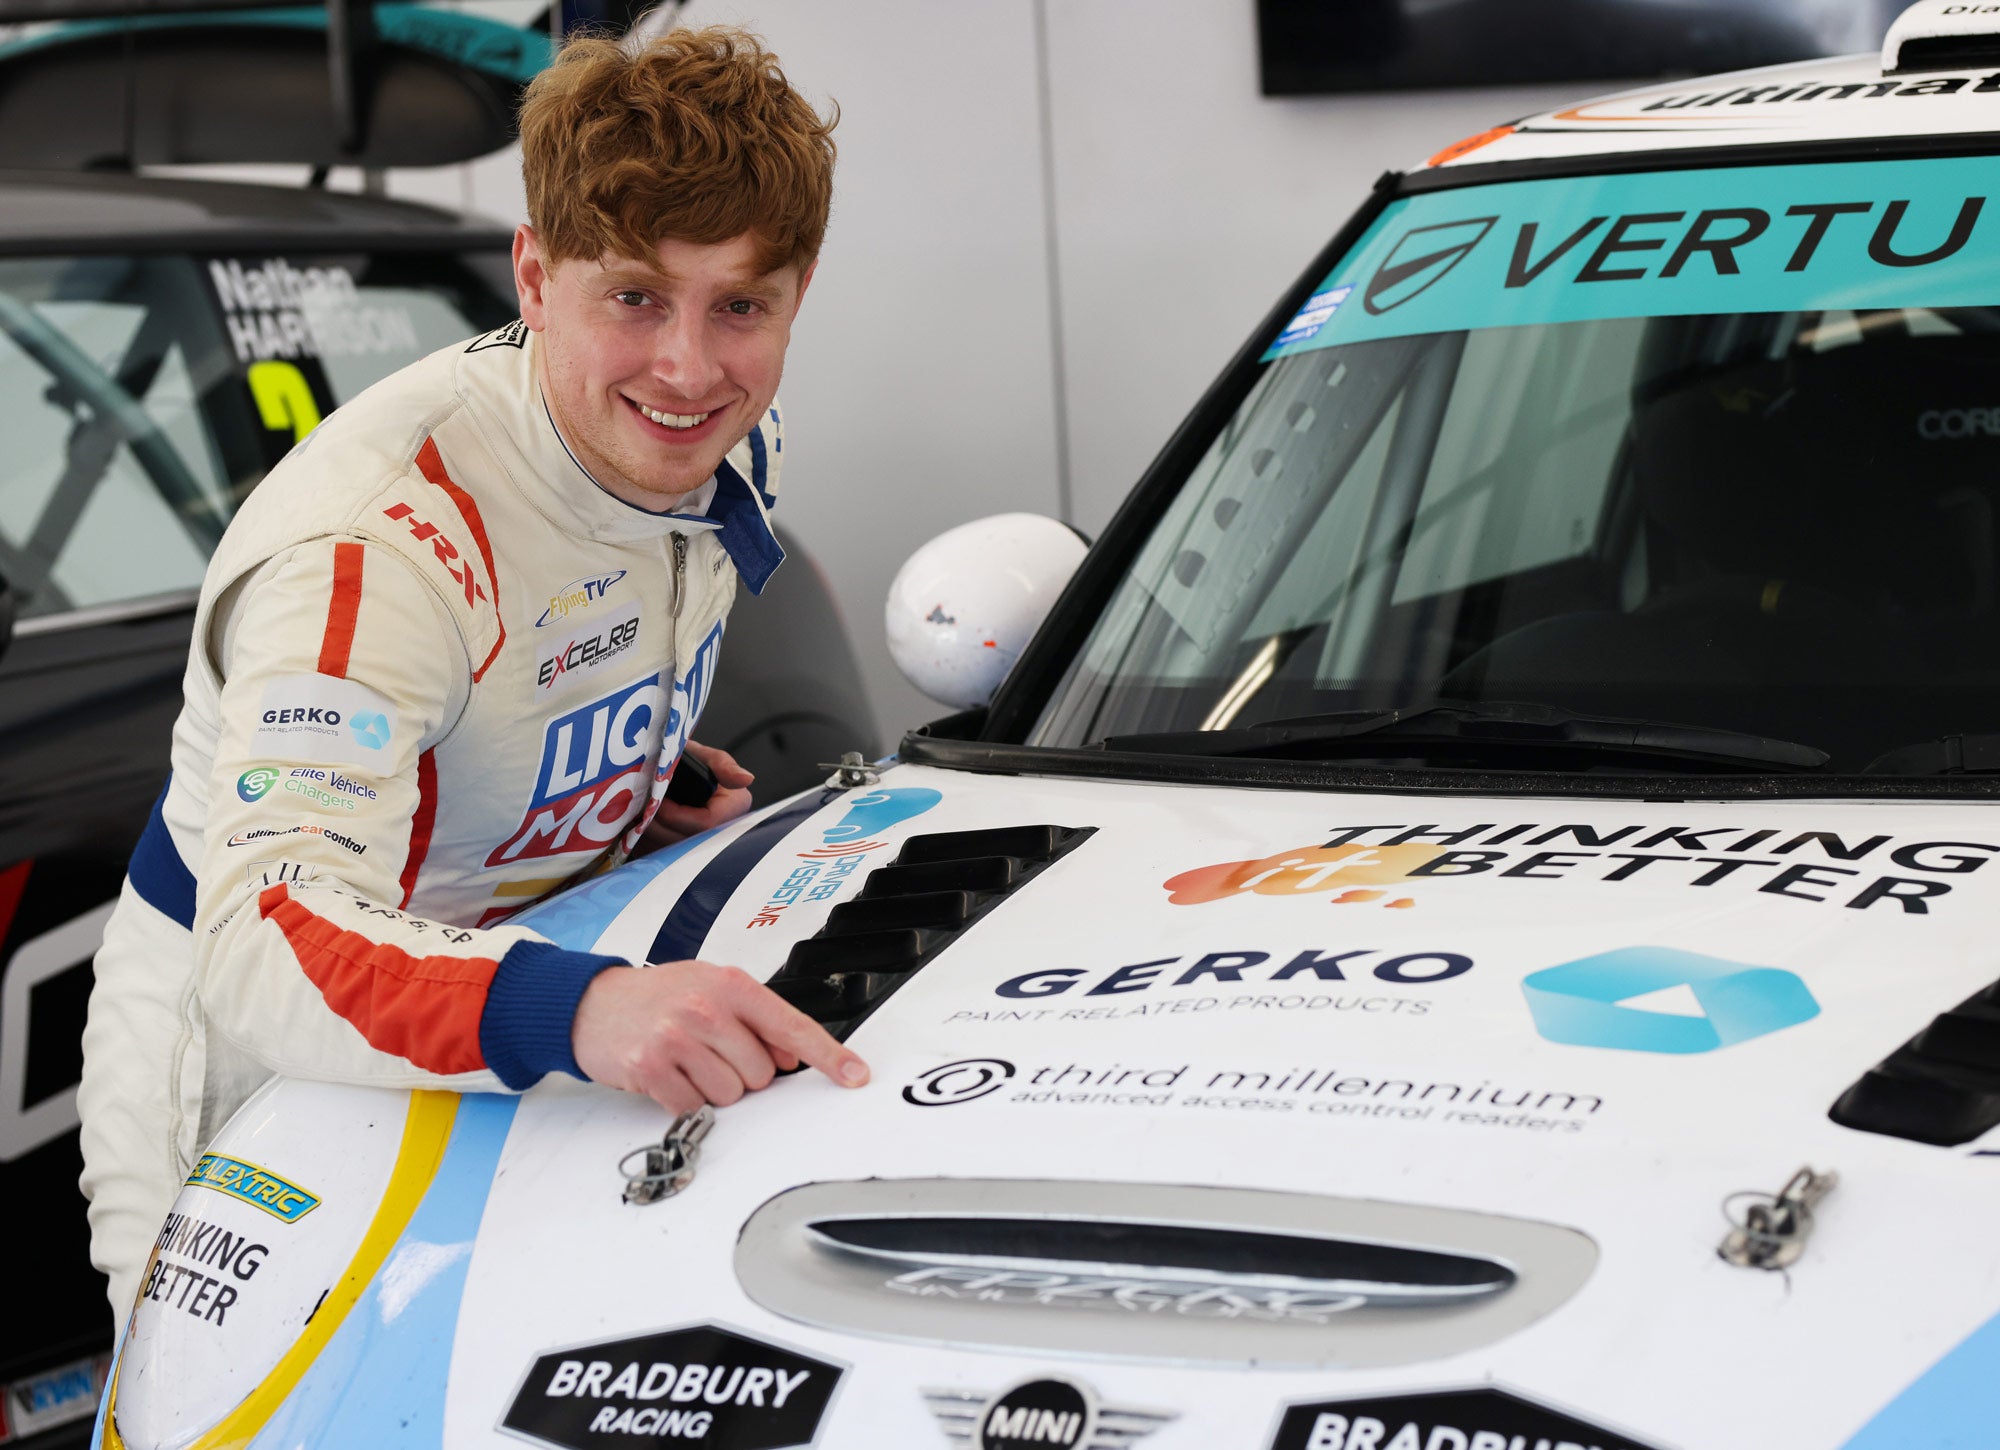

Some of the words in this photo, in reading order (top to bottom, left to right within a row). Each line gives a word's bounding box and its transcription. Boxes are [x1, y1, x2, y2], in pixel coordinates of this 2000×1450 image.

[1503, 196, 1987, 289] VERTU
[208, 256, 358, 312] Nathan
[382, 502, 488, 610] HRX
[537, 616, 640, 690] EXCELR8
[588, 639, 635, 668] MOTORSPORT
[262, 707, 342, 726] GERKO
[277, 726, 303, 734] RELATED
[304, 726, 339, 737] PRODUCTS
[284, 779, 355, 810] Chargers
[290, 768, 326, 781] Elite
[330, 771, 377, 800] Vehicle
[246, 825, 367, 855] ultimecarcontrol
[1318, 823, 2000, 874] THINKING
[802, 854, 867, 903] DRIVER
[1404, 850, 1953, 915] BETTER
[995, 949, 1475, 999] GERKO
[943, 1010, 1055, 1025] PAINT
[1058, 997, 1219, 1022] RELATED
[1228, 994, 1432, 1016] PRODUCTS
[1010, 1089, 1174, 1106] advanced
[1181, 1094, 1294, 1112] access
[1308, 1099, 1434, 1120] control
[1443, 1108, 1587, 1133] readers
[1030, 1063, 1191, 1088] third
[1206, 1066, 1604, 1114] millennium
[154, 1212, 270, 1281] THINKING
[143, 1259, 238, 1327] BETTER
[545, 1360, 812, 1408] BRADBURY
[588, 1405, 714, 1439] RACING
[986, 1404, 1083, 1446] MINI
[1305, 1412, 1615, 1450] BRADB
